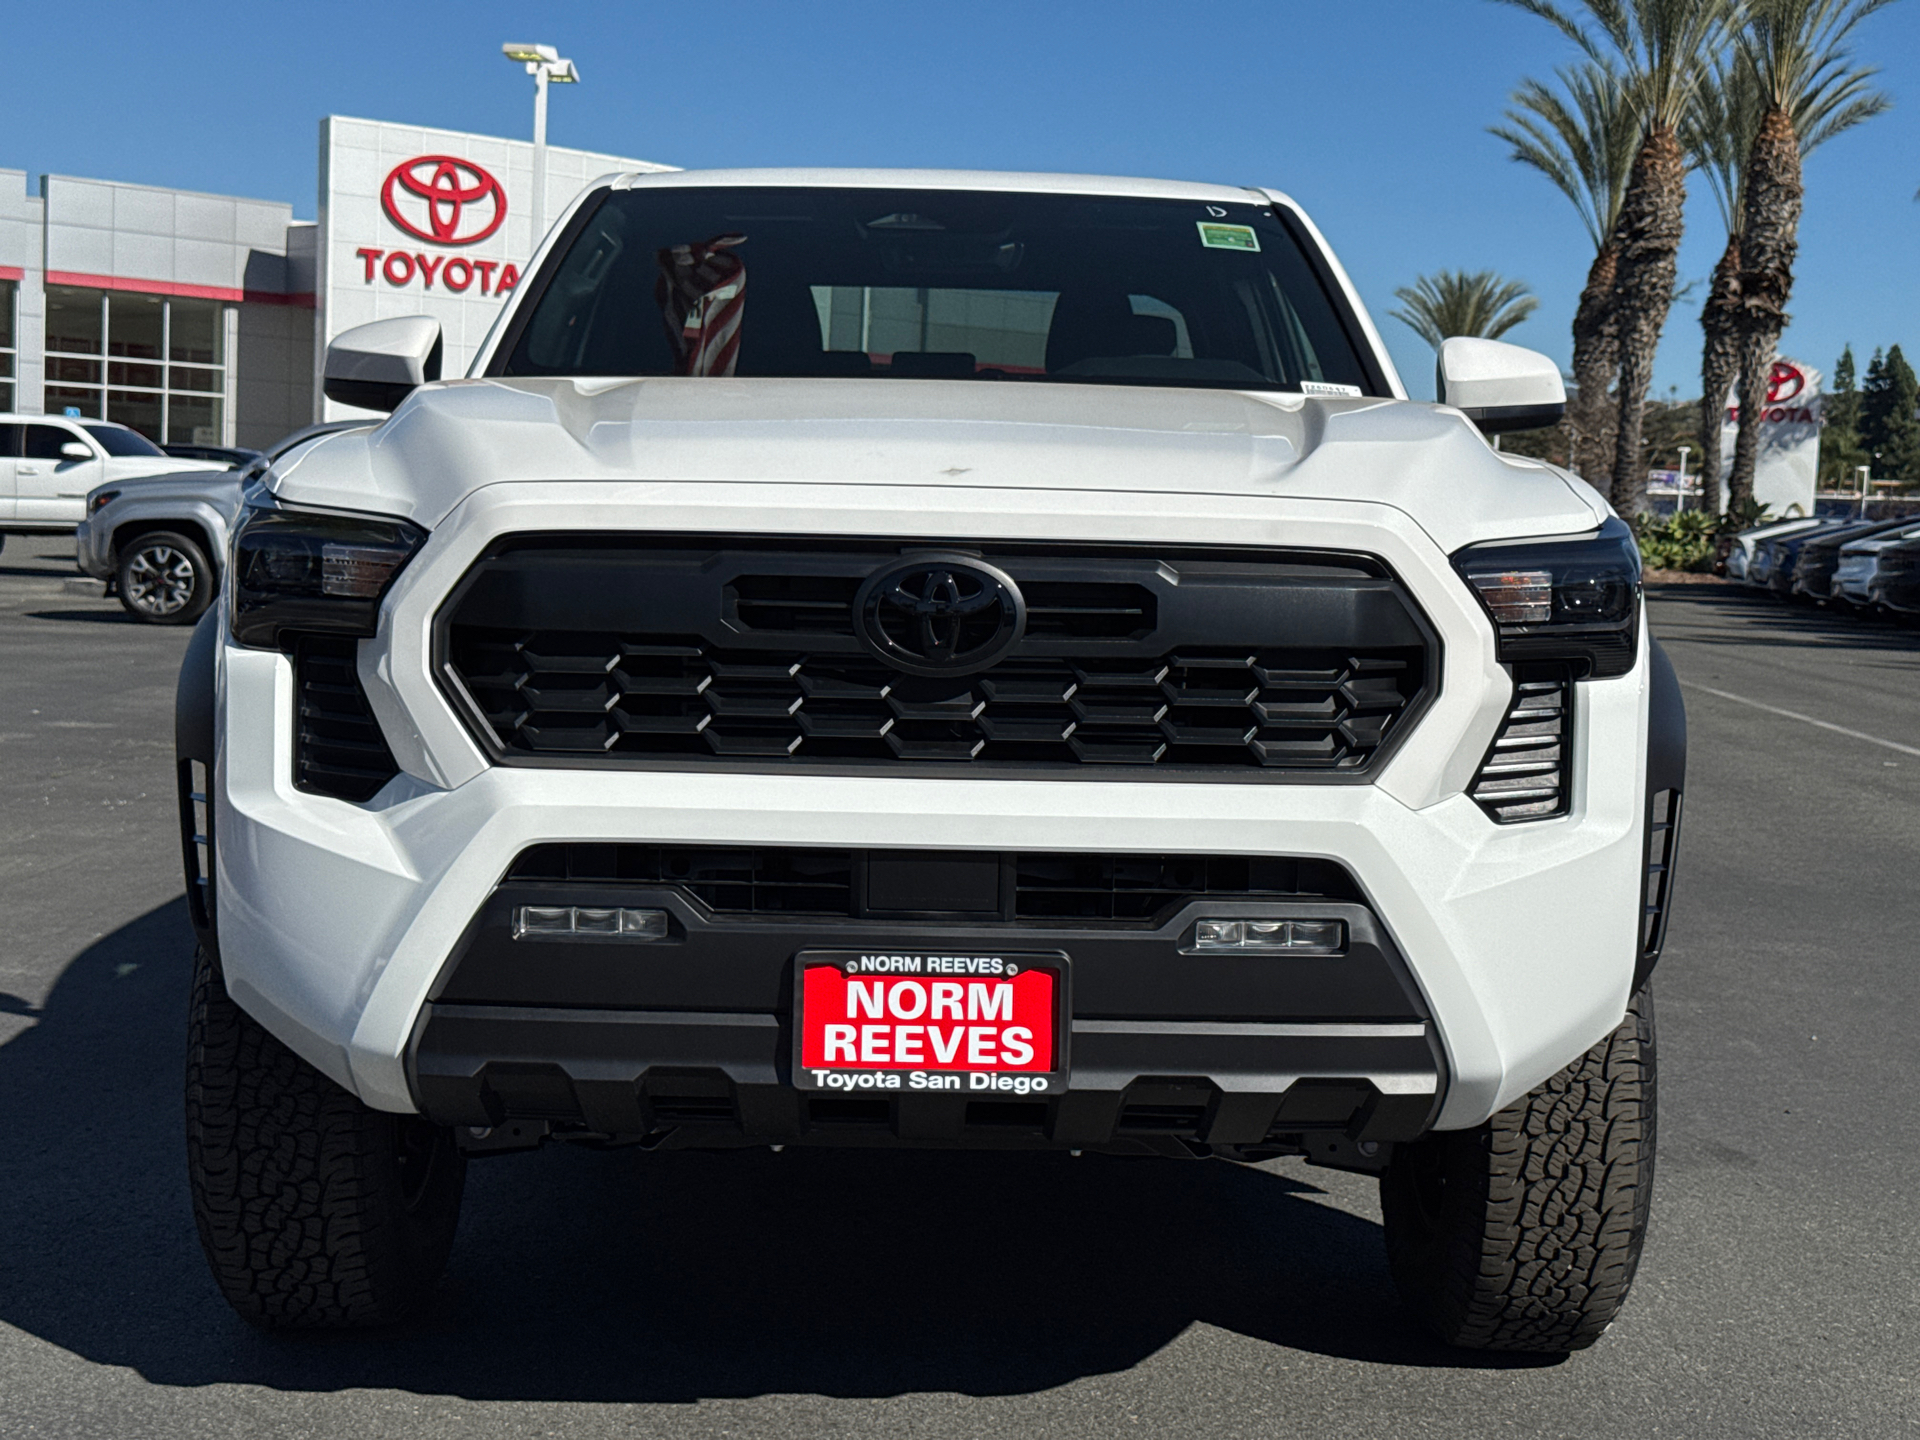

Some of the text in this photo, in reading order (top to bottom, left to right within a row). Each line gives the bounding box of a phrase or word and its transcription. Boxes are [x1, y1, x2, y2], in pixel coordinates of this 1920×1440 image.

[356, 247, 521, 298] TOYOTA
[860, 956, 1004, 974] NORM REEVES
[846, 980, 1014, 1021] NORM
[823, 1023, 1035, 1066] REEVES
[811, 1069, 1049, 1095] Toyota San Diego
